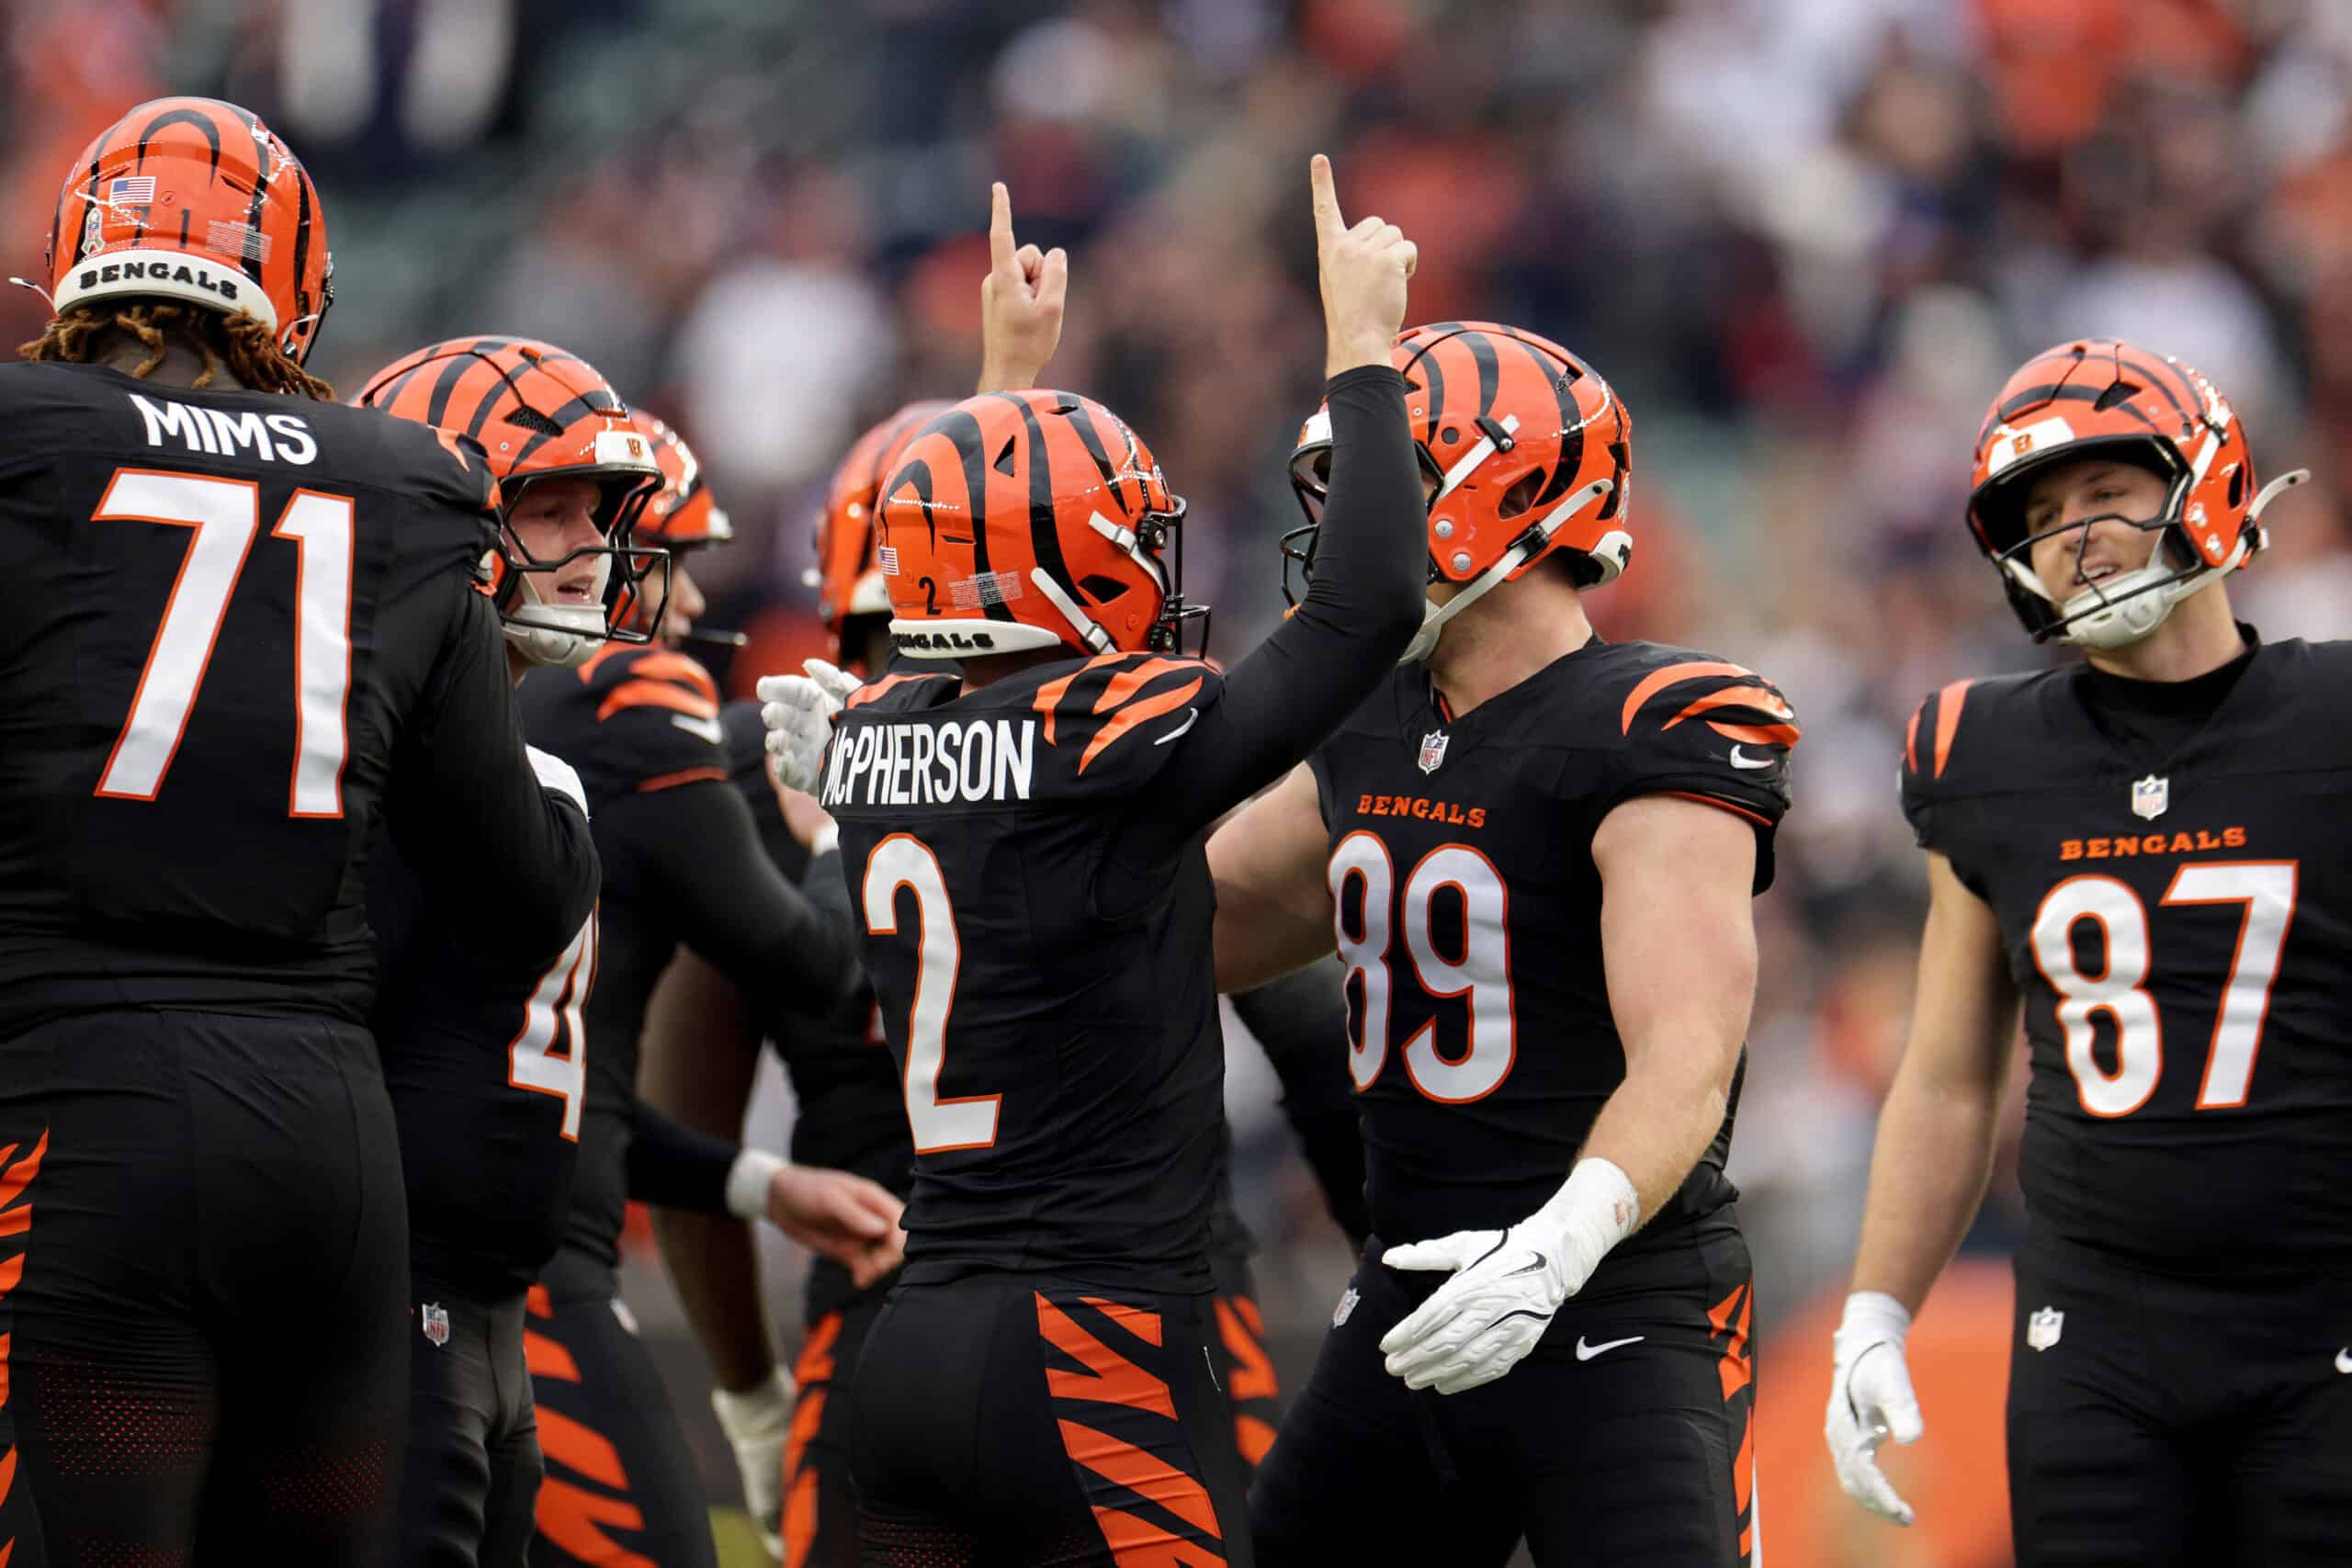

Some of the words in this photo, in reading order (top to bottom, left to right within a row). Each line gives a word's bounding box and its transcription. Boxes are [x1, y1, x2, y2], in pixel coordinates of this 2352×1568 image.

[79, 262, 238, 300] BENGALS
[129, 393, 318, 466] MIMS
[91, 467, 356, 819] 71
[918, 576, 942, 615] 2
[1356, 794, 1487, 829] BENGALS
[2060, 827, 2248, 861] BENGALS
[508, 896, 600, 1144] 4
[862, 831, 1003, 1156] 2
[1327, 829, 1517, 1105] 89
[2029, 858, 2299, 1119] 87
